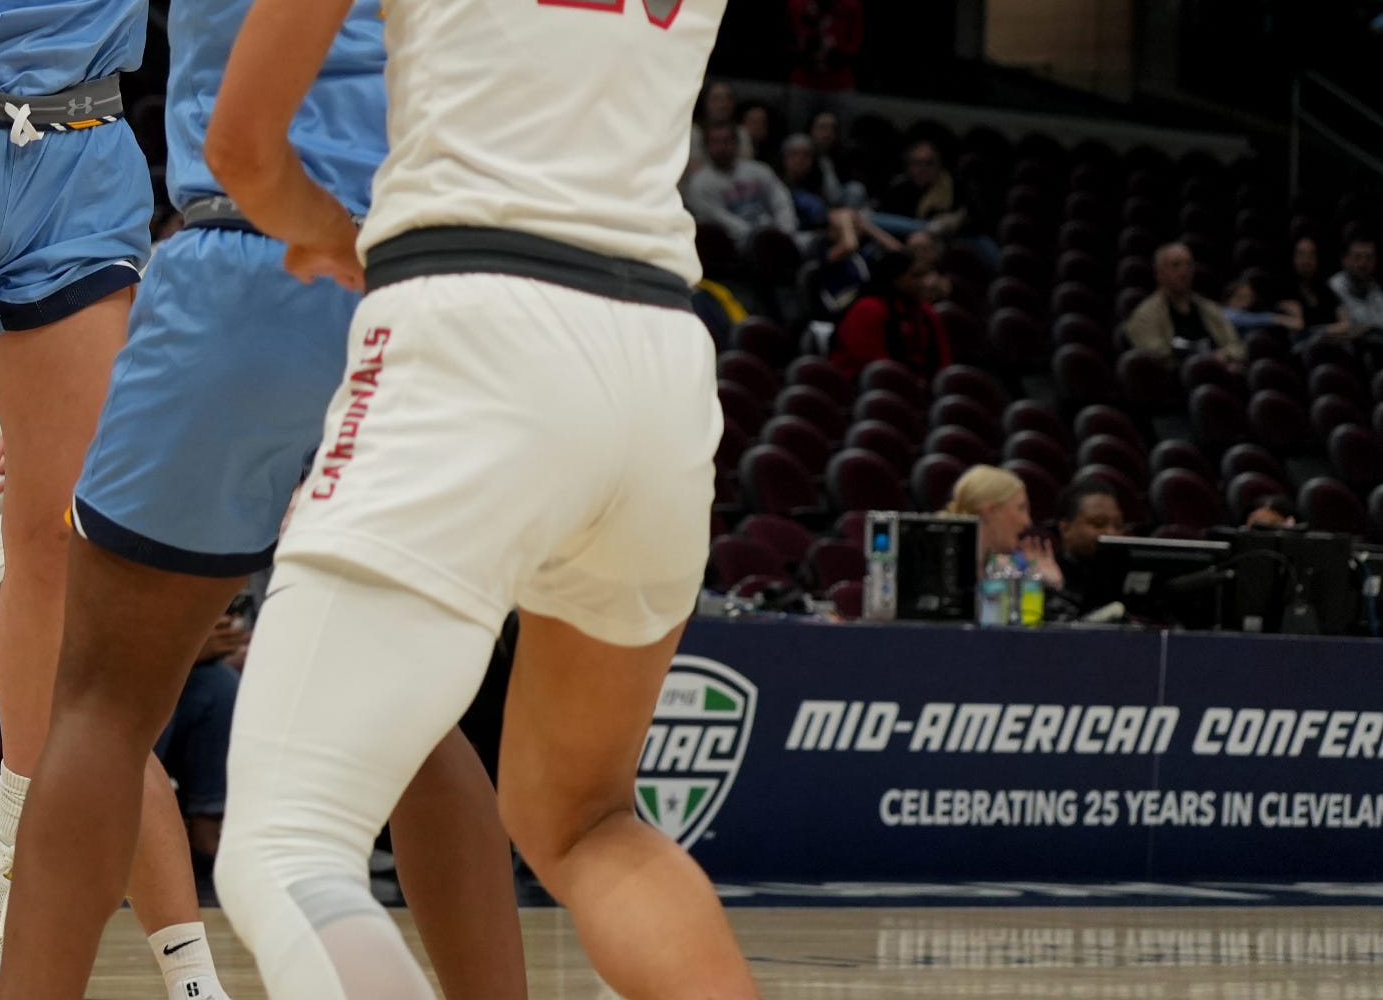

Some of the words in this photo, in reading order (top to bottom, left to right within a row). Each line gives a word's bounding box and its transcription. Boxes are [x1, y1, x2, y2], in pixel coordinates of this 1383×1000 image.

[784, 700, 1181, 754] MID-AMERICAN
[1191, 707, 1383, 759] CONFER
[879, 788, 1078, 827] CELEBRATING
[1082, 789, 1120, 827] 25
[1125, 790, 1216, 827] YEARS
[1220, 791, 1254, 828] IN
